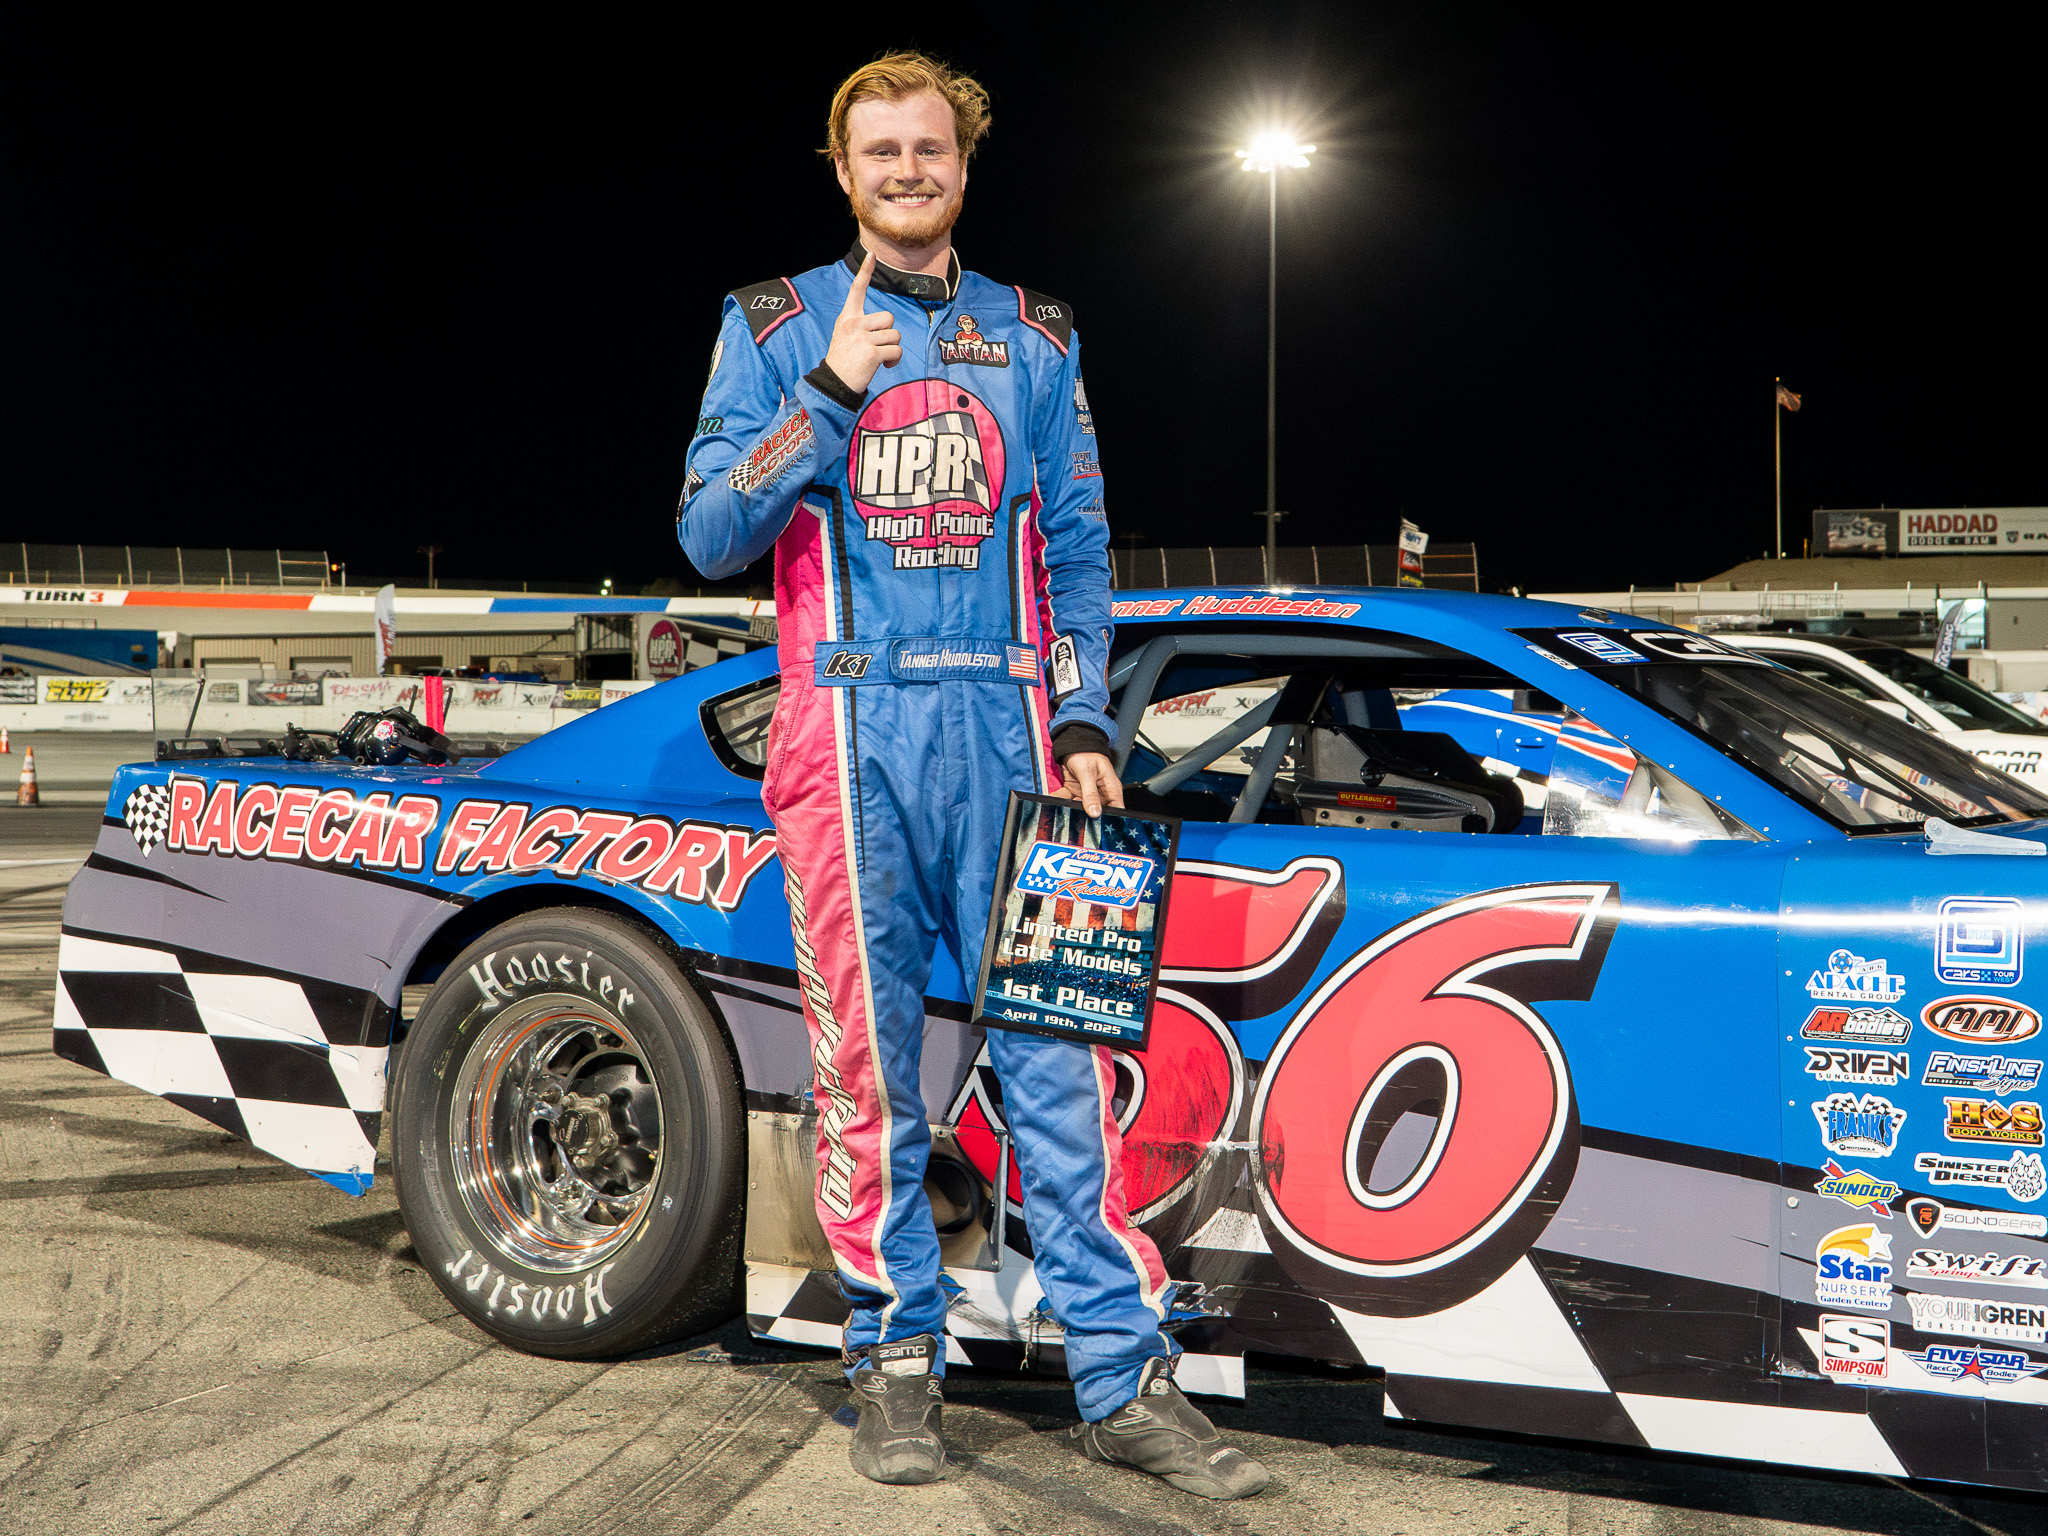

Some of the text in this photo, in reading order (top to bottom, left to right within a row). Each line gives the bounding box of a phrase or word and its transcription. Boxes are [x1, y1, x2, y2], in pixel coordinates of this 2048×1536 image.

[750, 295, 786, 310] K1
[1036, 305, 1062, 321] K1
[939, 340, 1007, 362] TANTAN
[752, 407, 810, 468] RACECA
[860, 432, 969, 497] HPR
[867, 511, 995, 541] High Point
[1907, 514, 1998, 533] HADDAD
[1909, 537, 1990, 546] DODGE RAM
[893, 542, 980, 570] Racing
[23, 590, 104, 603] TURN 3
[1111, 596, 1361, 619] nner Huddleston
[823, 650, 873, 678] K1
[167, 780, 776, 909] RACECAR FACTORY
[1071, 848, 1101, 863] Kevin
[1028, 848, 1143, 889] KERN
[1047, 877, 1139, 904] Raceway
[1010, 915, 1142, 953] Limited Pro
[1001, 937, 1142, 977] Late Models
[469, 950, 635, 1015] Hoosier
[1807, 973, 1904, 993] APACHE
[1003, 978, 1134, 1017] 1st Place
[1813, 990, 1855, 998] RENTAL
[1002, 1008, 1122, 1035] April 19th, 2025
[1939, 1007, 2026, 1035] MMI
[1808, 1050, 1907, 1076] DRIVEN
[1818, 1073, 1896, 1084] SUNGLASSES
[1980, 1072, 2034, 1094] Signs
[1828, 1110, 1893, 1147] FRANK'S
[1953, 1128, 2035, 1140] BODY WORKS
[1919, 1158, 2010, 1174] SINISTER
[1933, 1170, 2006, 1184] DIESEL
[1823, 1181, 1893, 1198] SUNOCO
[1943, 1213, 2042, 1230] SOUNDGEAR
[1819, 1254, 1890, 1282] Star
[1927, 1268, 1981, 1279] springs
[445, 1249, 615, 1325] Hoosier
[1820, 1282, 1888, 1298] NURSERY
[1820, 1295, 1889, 1308] Garden Centers
[1911, 1297, 2045, 1328] YOUNGREN
[1916, 1319, 2042, 1339] CONSTRUCTION
[879, 1346, 926, 1358] zamp
[1927, 1347, 2026, 1369] FIVE STAR
[1825, 1358, 1885, 1376] SIMPSON
[1926, 1363, 2018, 1378] RaceCar Bodies
